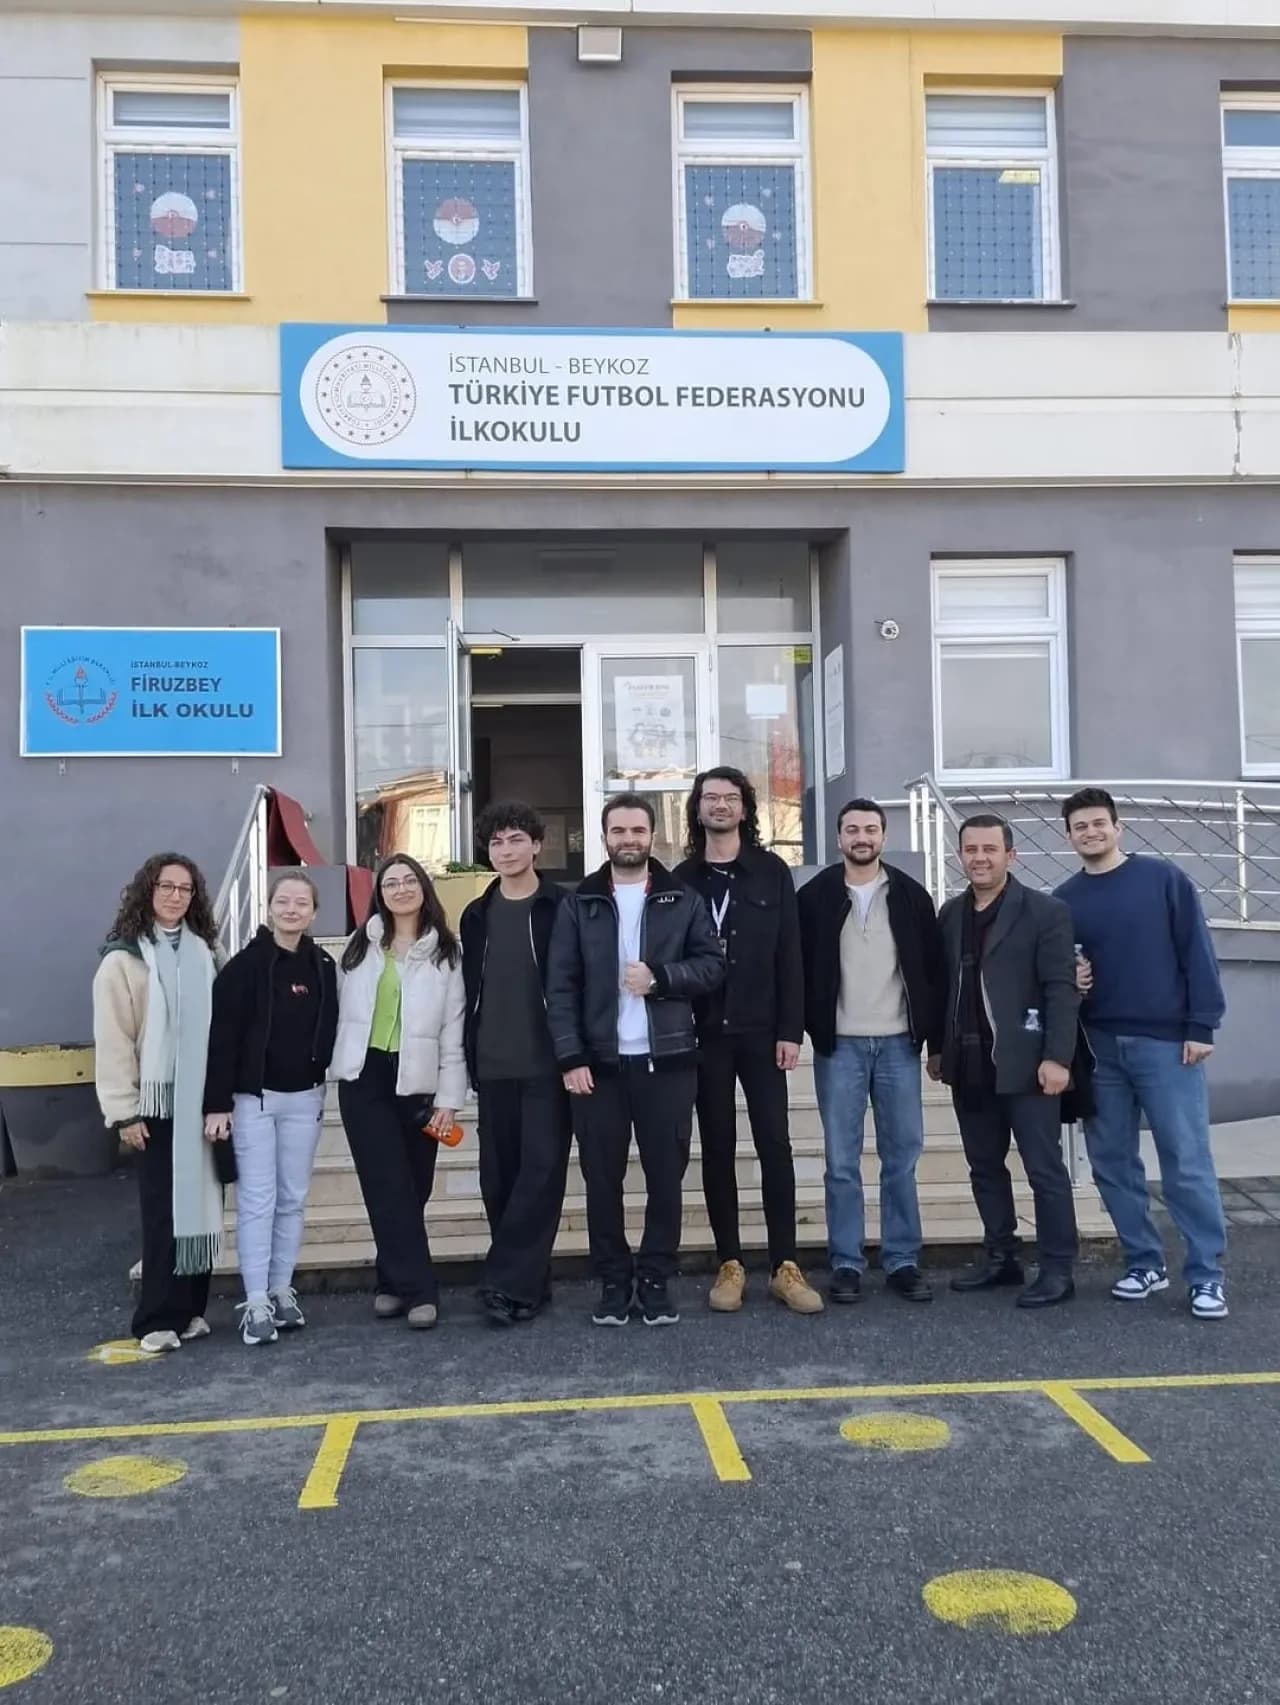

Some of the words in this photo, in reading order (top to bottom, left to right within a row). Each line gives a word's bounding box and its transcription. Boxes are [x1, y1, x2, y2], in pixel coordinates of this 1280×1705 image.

[449, 352, 550, 374] İSTANBUL
[569, 357, 649, 375] BEYKOZ
[448, 379, 560, 406] TÜRKİYE
[567, 385, 669, 407] FUTBOL
[676, 386, 865, 409] FEDERASYONU
[451, 415, 581, 442] İLKOKULU
[131, 673, 222, 693] FİRUZBEY
[131, 699, 169, 718] İLK
[176, 703, 254, 719] OKULU
